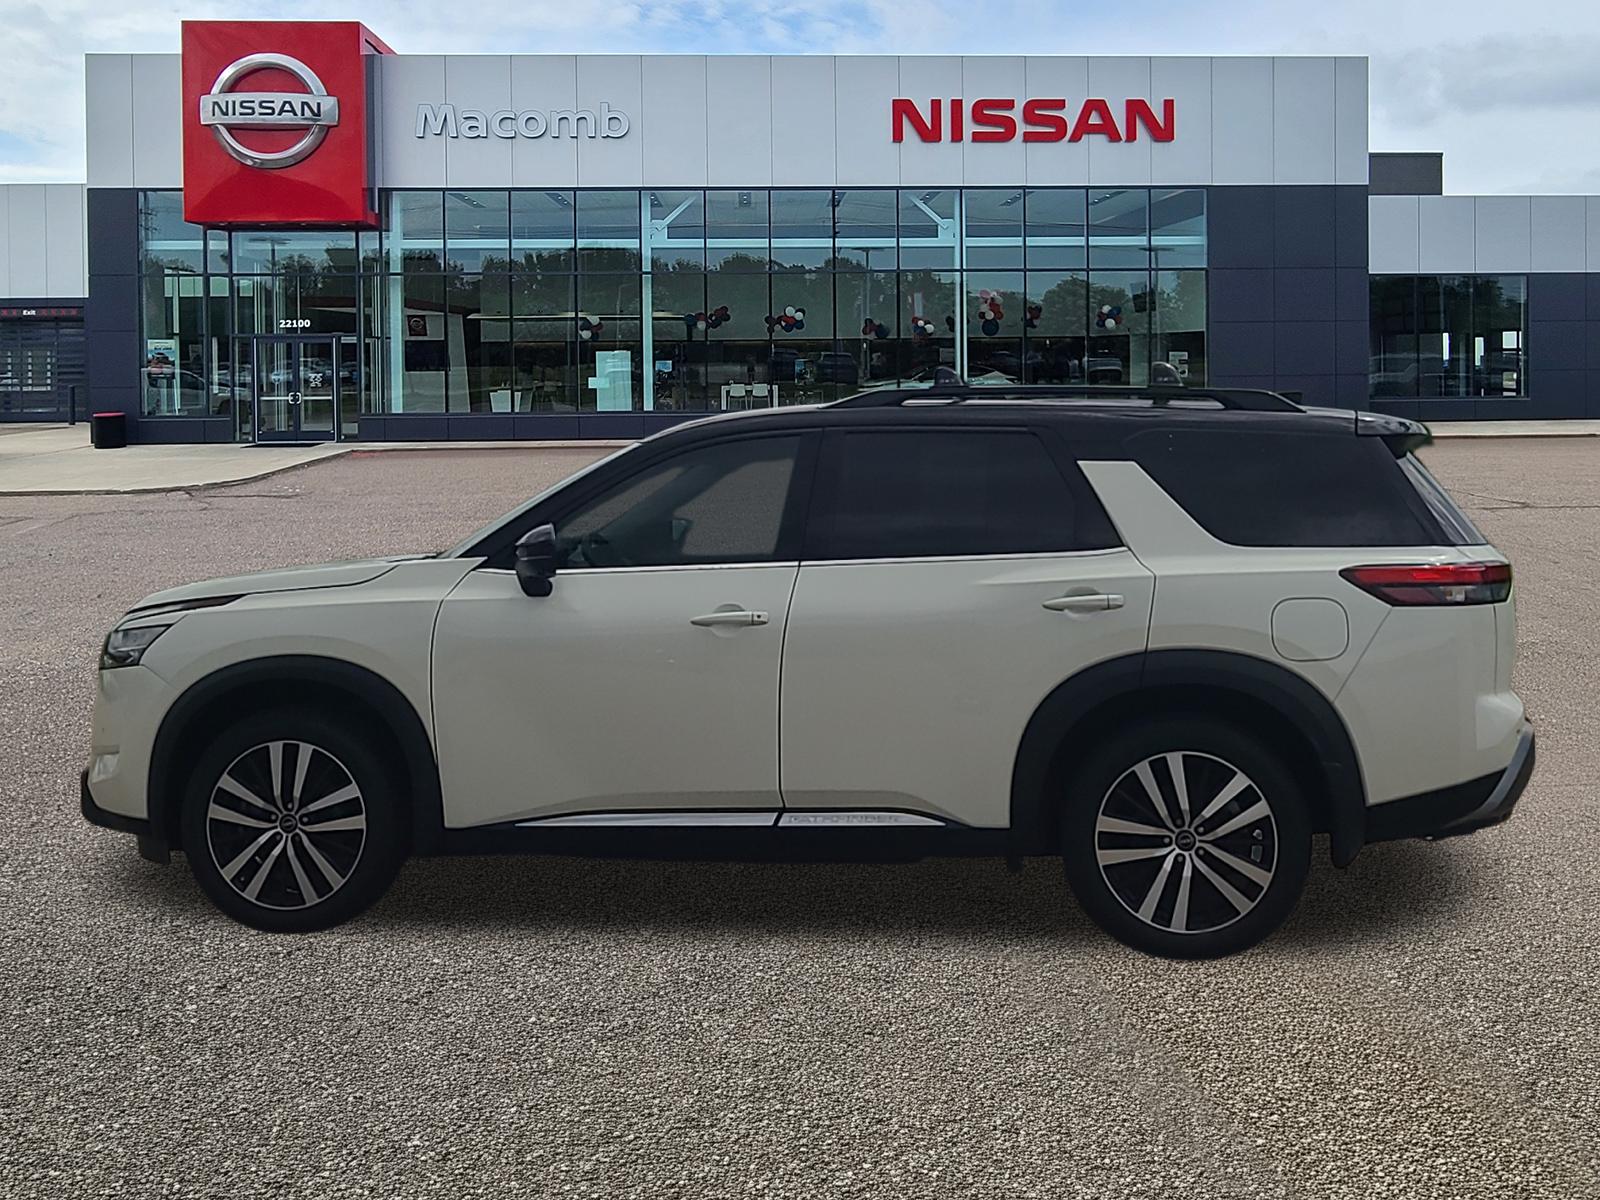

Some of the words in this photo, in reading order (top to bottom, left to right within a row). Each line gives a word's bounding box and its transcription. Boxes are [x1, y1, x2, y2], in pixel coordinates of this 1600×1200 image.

[212, 100, 322, 117] NISSAN
[415, 102, 630, 139] Macomb
[892, 99, 1175, 143] NISSAN
[279, 319, 311, 328] 22100
